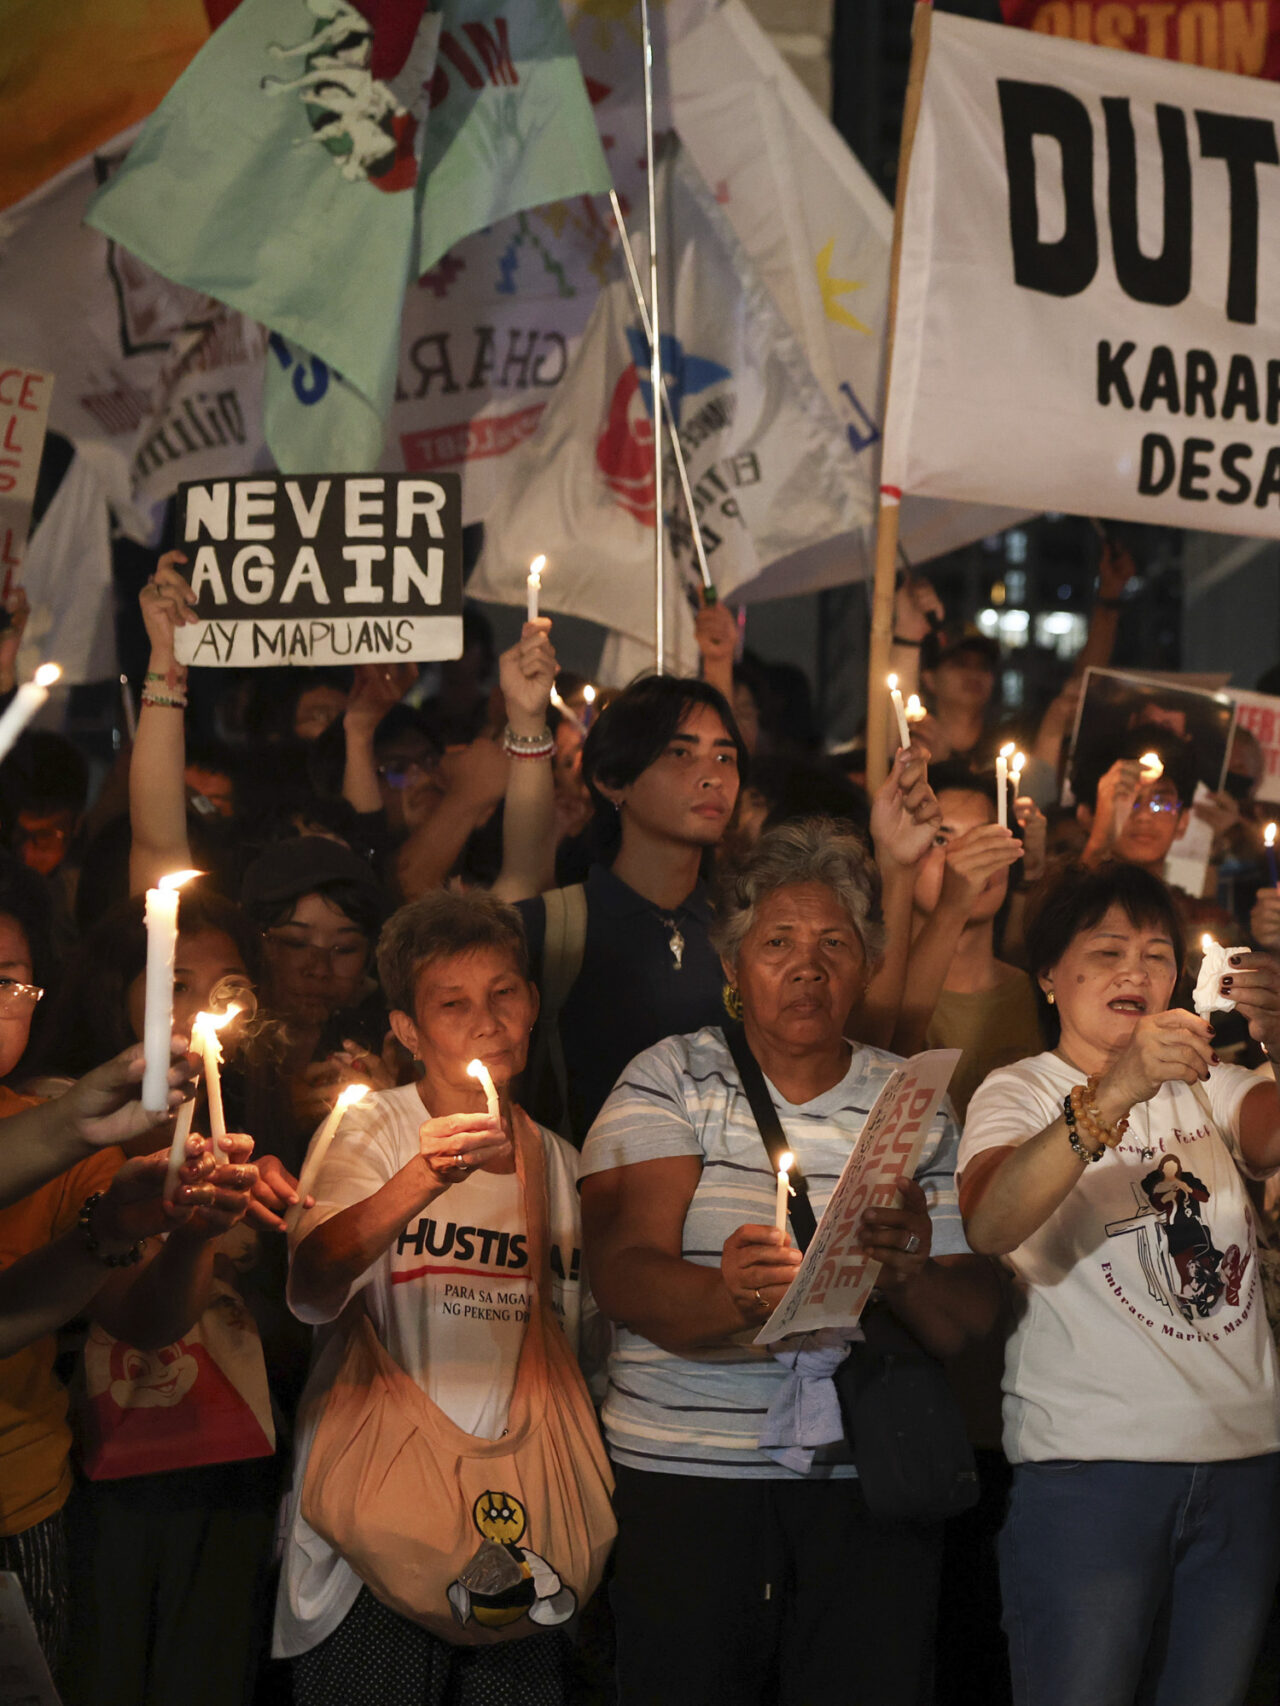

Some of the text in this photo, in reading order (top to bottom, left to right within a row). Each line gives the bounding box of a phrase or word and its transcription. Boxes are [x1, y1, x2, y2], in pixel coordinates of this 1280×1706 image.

[184, 478, 446, 543] NEVER
[190, 544, 445, 606] AGAIN
[192, 620, 415, 663] AY MAPUANS
[833, 1088, 935, 1289] DUTETE
[396, 1217, 581, 1282] HUSTISA!
[441, 1302, 462, 1316] NG
[464, 1305, 511, 1322] PEKENG
[444, 1284, 475, 1301] PARA
[478, 1290, 494, 1305] SA
[496, 1292, 525, 1306] MGA
[1101, 1261, 1155, 1328] Embrace
